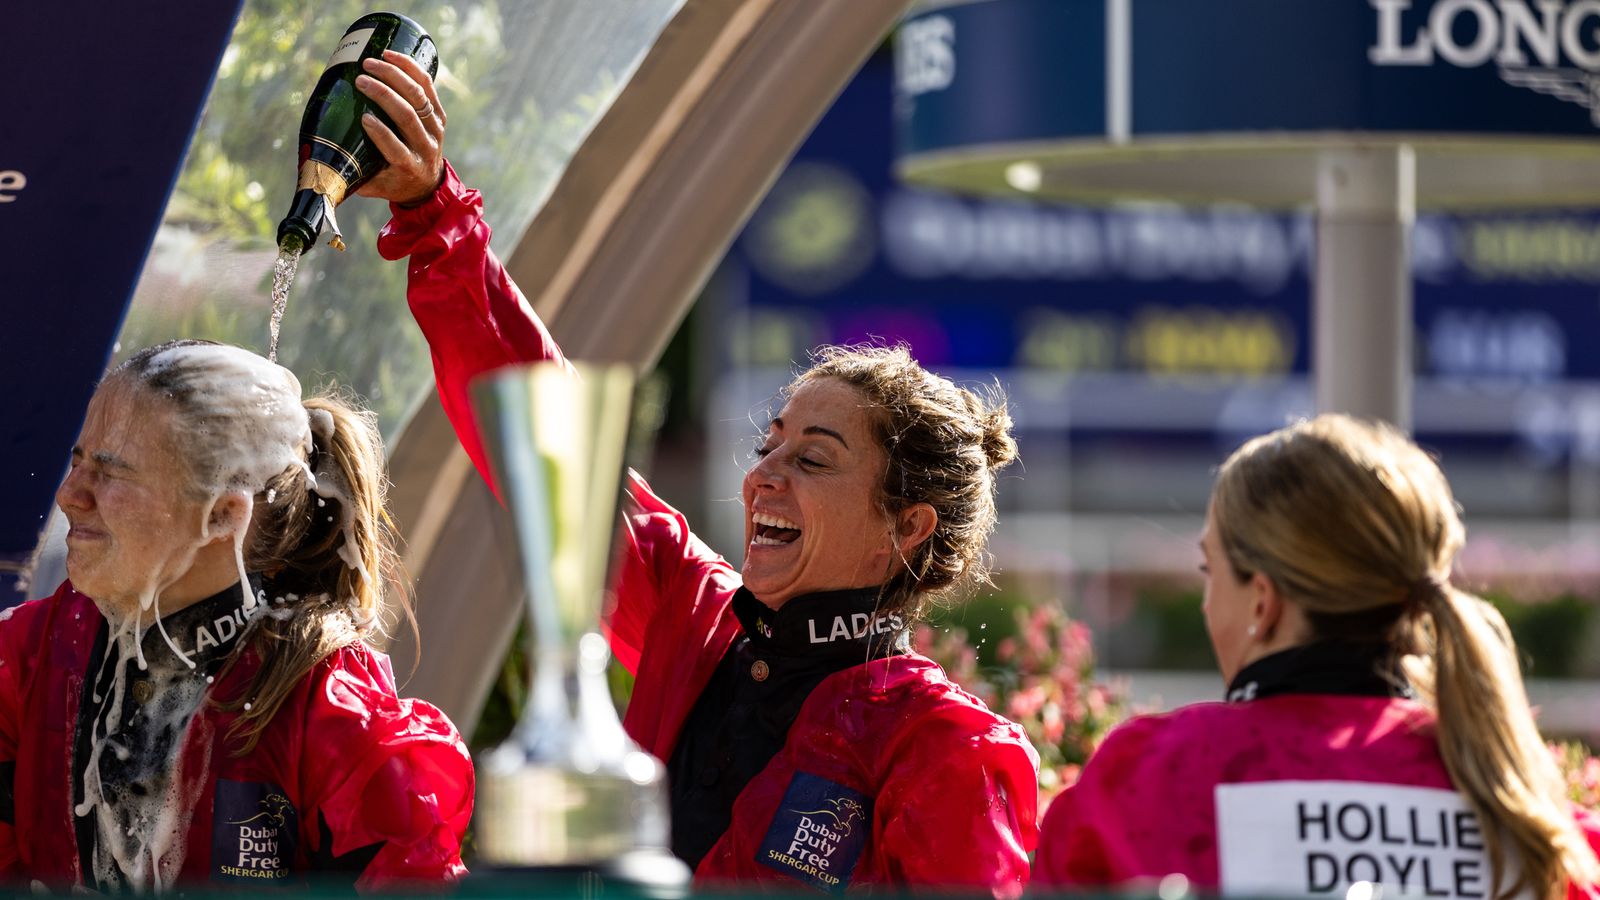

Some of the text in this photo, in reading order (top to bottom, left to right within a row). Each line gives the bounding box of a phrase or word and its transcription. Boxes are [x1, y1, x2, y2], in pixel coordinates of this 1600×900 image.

[808, 610, 904, 644] LADIES
[240, 826, 278, 839] Dubai
[801, 816, 842, 842] Dubai
[1298, 802, 1485, 851] HOLLIE
[240, 838, 278, 855] Duty
[787, 840, 830, 871] Free
[794, 827, 837, 857] Duty
[221, 865, 274, 879] SHERGAR
[238, 852, 280, 869] Free
[768, 849, 840, 886] SHERGAR CUP
[1307, 852, 1484, 899] DOYLE
